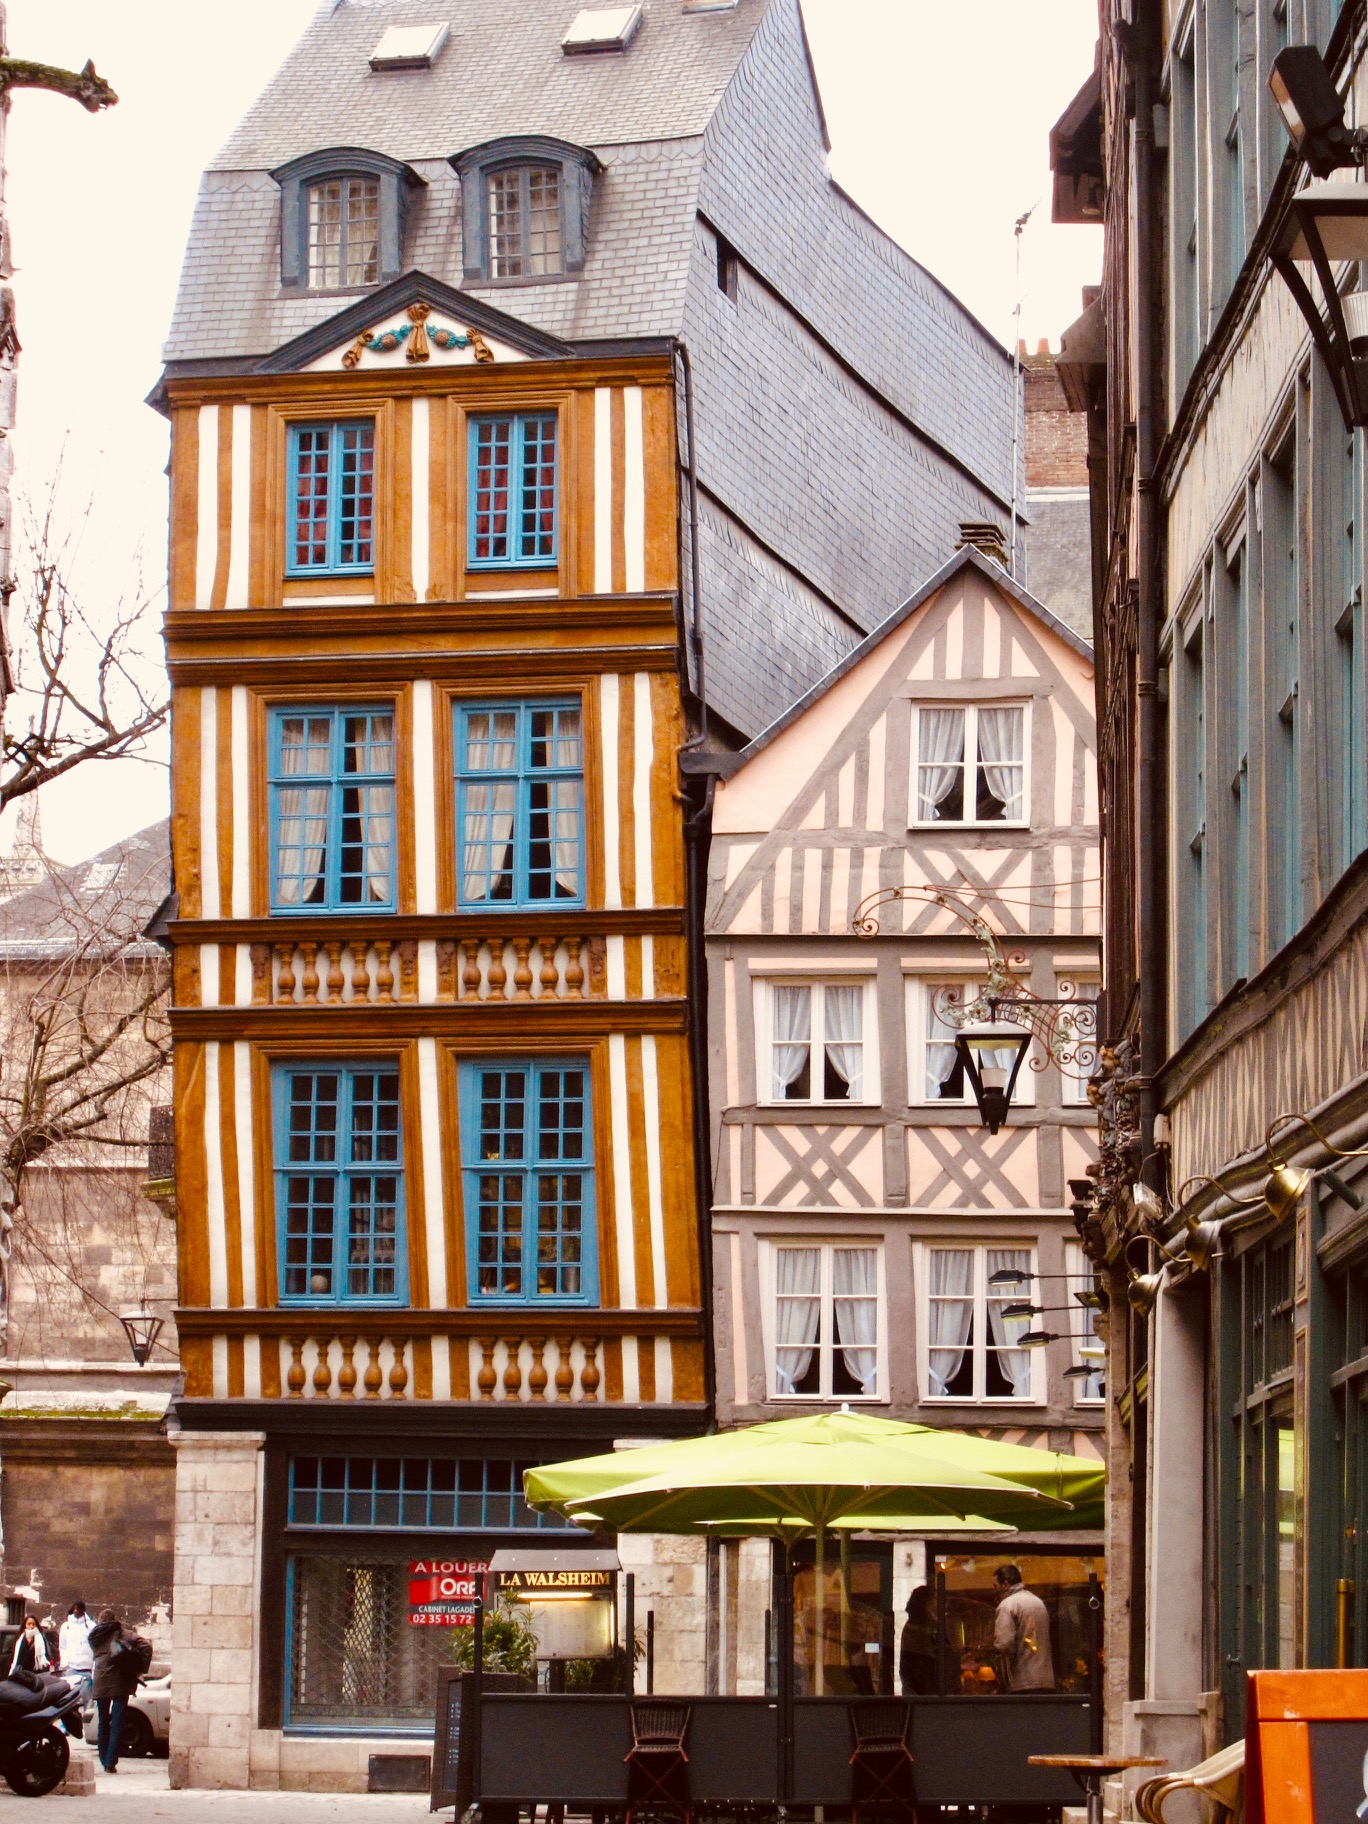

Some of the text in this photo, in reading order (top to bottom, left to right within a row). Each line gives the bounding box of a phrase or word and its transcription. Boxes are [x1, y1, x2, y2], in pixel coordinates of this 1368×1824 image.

[414, 1561, 488, 1574] A LOUER
[500, 1572, 610, 1586] LA WALSHEIM
[418, 1605, 446, 1613] CABINET
[412, 1613, 472, 1624] 02 35 15 72
